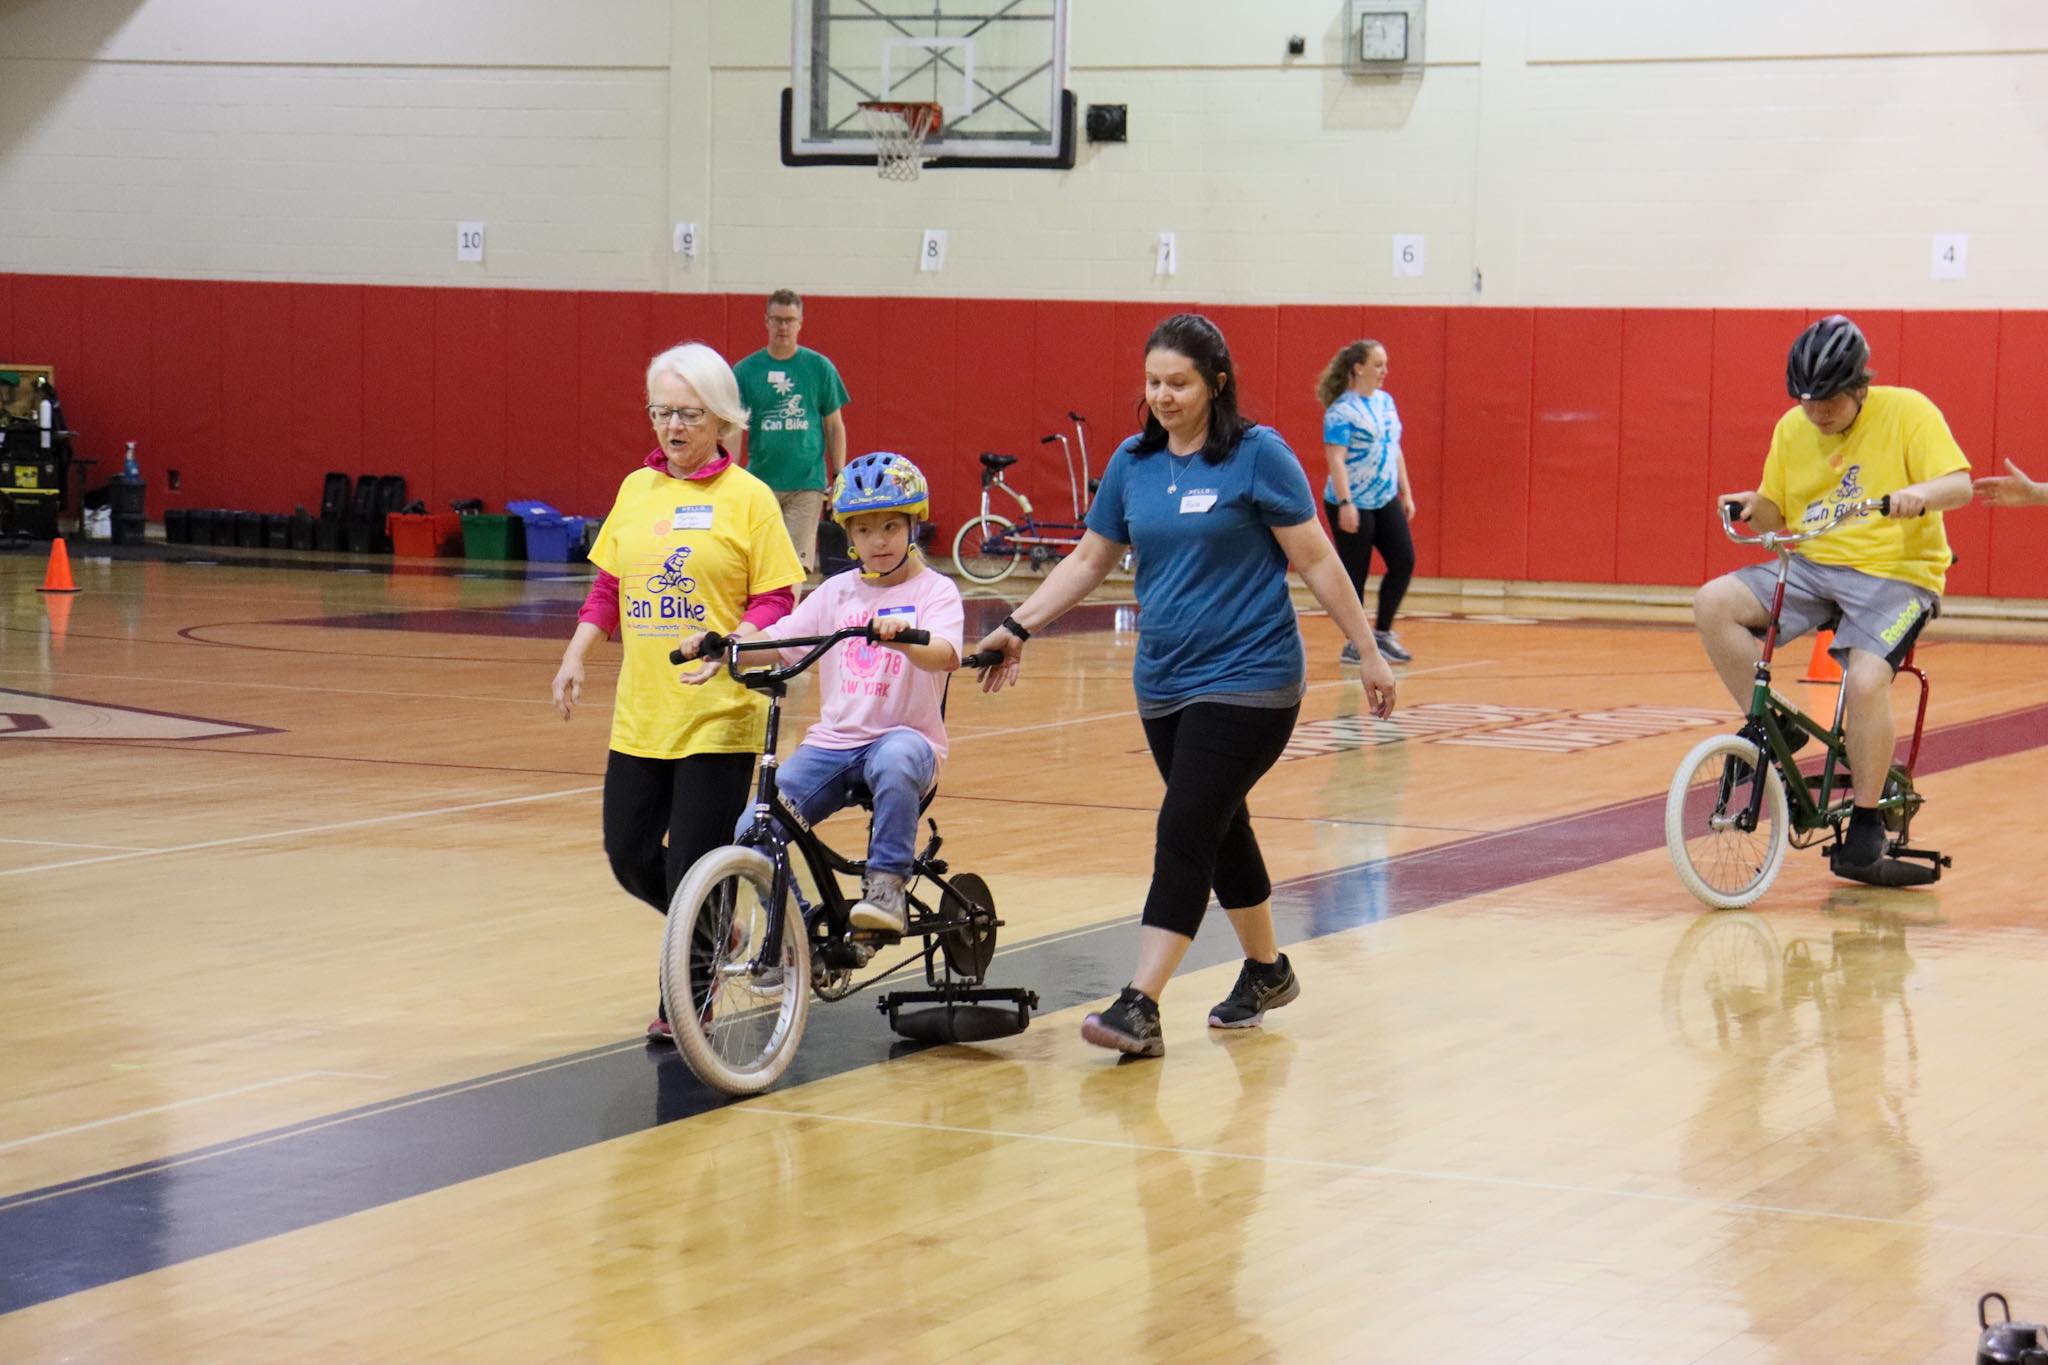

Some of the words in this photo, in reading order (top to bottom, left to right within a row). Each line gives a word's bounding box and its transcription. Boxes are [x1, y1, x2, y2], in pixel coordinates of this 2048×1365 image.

[461, 231, 481, 249] 10
[683, 232, 693, 251] 9
[927, 239, 938, 257] 8
[1402, 245, 1415, 263] 6
[1943, 245, 1955, 263] 4
[785, 417, 809, 431] Bike
[660, 596, 705, 622] Bike
